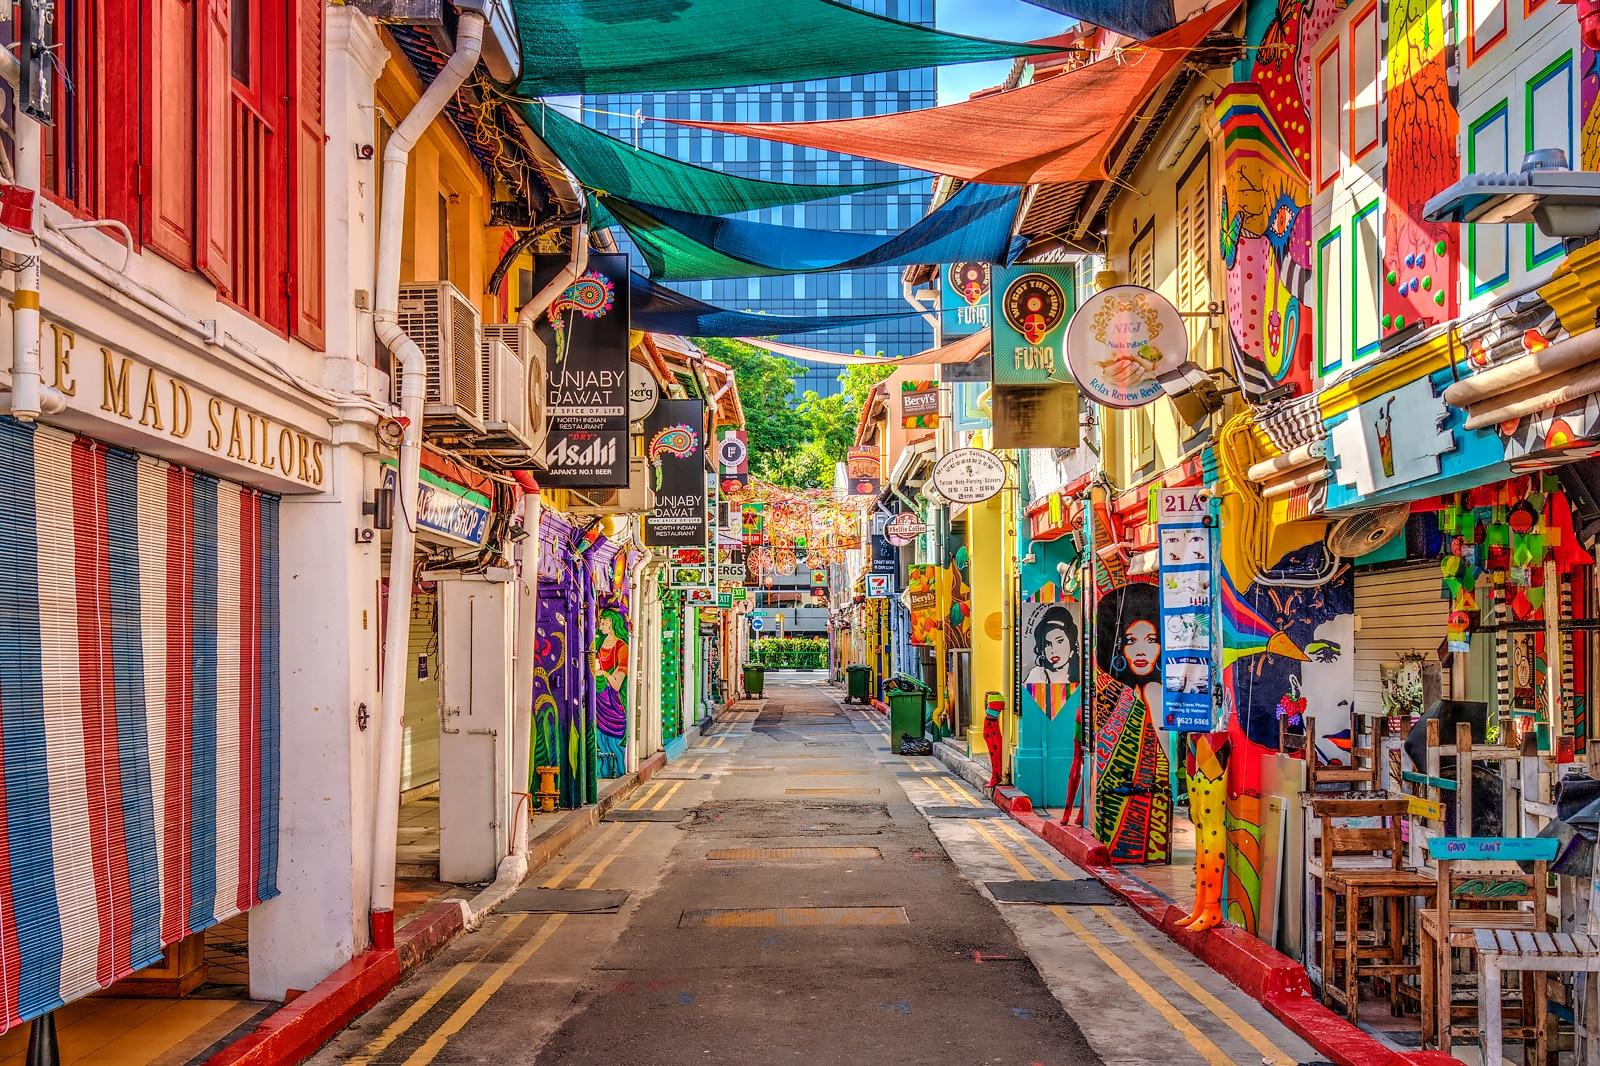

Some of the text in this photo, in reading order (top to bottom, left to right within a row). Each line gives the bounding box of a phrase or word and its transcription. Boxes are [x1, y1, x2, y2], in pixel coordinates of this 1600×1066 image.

[1011, 280, 1058, 318] WE GOT THE FUNK
[1107, 339, 1148, 349] Nails Palace
[546, 370, 625, 391] UNJABY
[1089, 377, 1109, 396] Relax
[1111, 389, 1139, 401] Renew
[550, 391, 613, 405] DAWAT
[903, 394, 936, 408] Beryl's
[100, 347, 192, 439] MAD
[208, 397, 324, 486] SAILORS
[546, 437, 617, 466] Asahi
[727, 446, 737, 458] F
[655, 495, 702, 509] UNJABY
[1165, 493, 1203, 512] 21A
[434, 499, 459, 530] SILK
[454, 506, 479, 538] SHOP
[655, 508, 695, 517] DAWAT
[718, 566, 743, 575] ERGS
[872, 578, 884, 586] 7
[718, 595, 730, 603] XIT
[1448, 842, 1466, 852] GOOD
[1480, 842, 1501, 852] CAN'T
